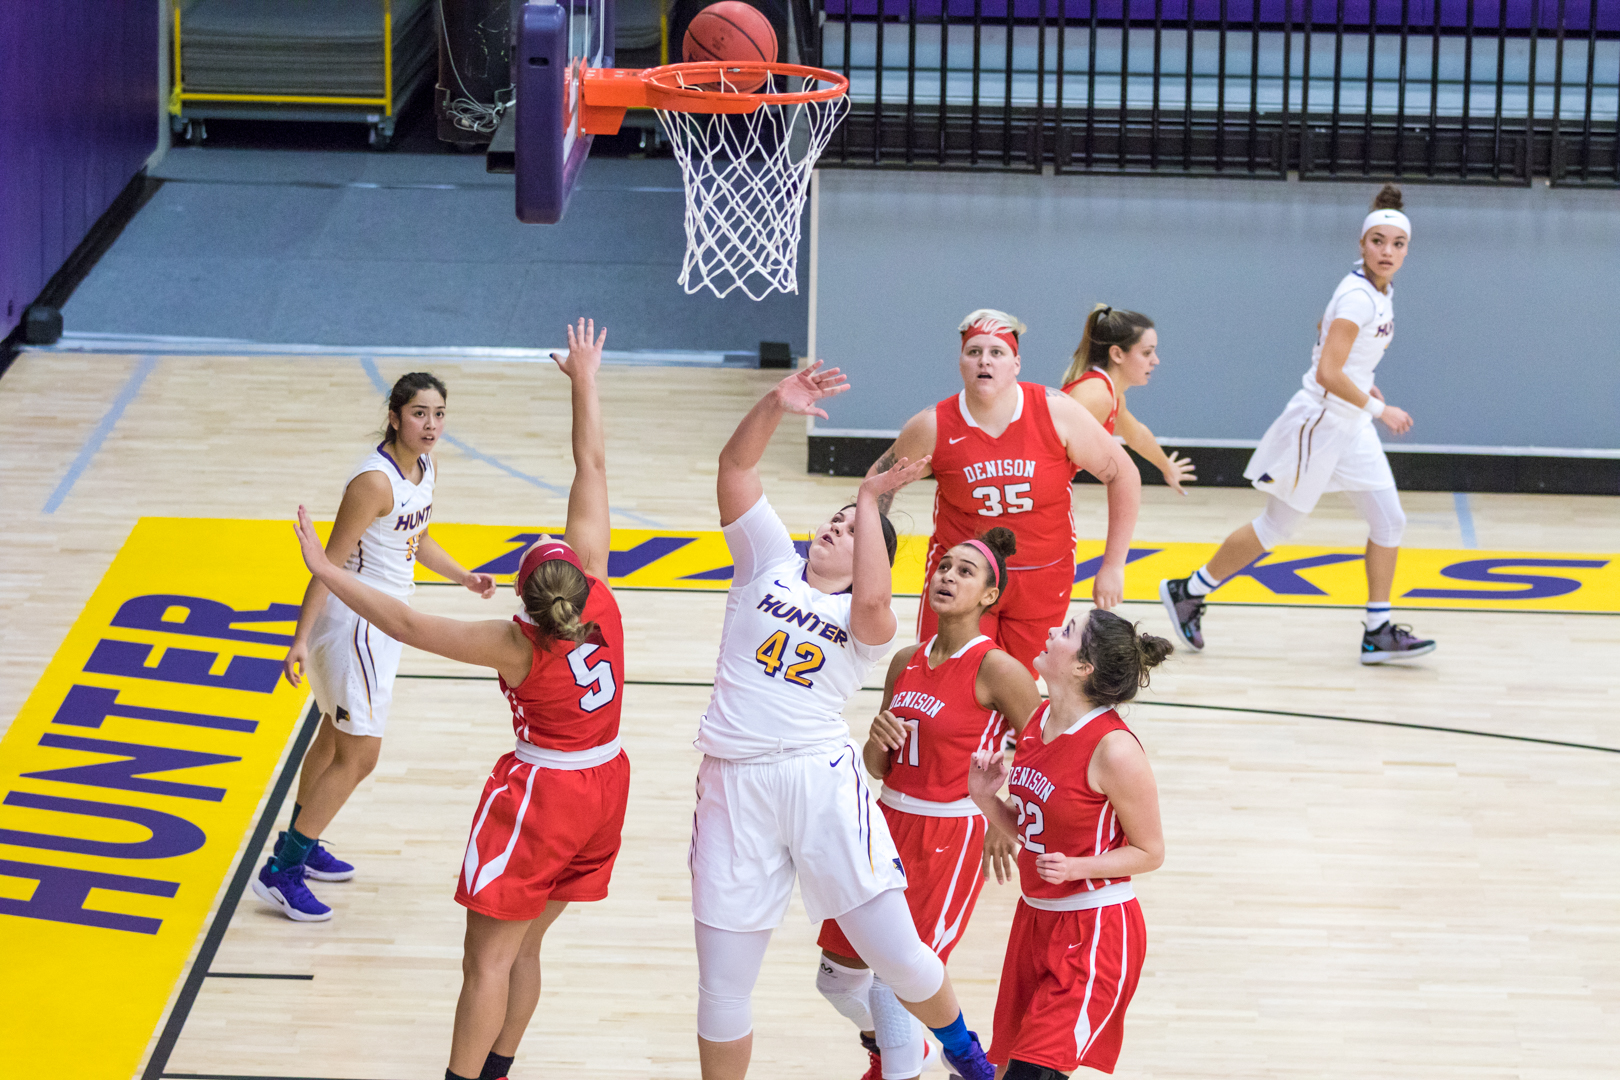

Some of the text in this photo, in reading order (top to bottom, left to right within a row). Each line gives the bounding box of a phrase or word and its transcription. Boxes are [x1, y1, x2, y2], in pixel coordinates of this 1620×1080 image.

[963, 459, 1036, 483] DENISON
[393, 504, 432, 531] HUNT
[972, 481, 1034, 517] 35
[756, 593, 848, 648] HUNTER
[565, 643, 616, 713] 5
[756, 629, 826, 689] 42
[0, 594, 303, 936] HUNTER
